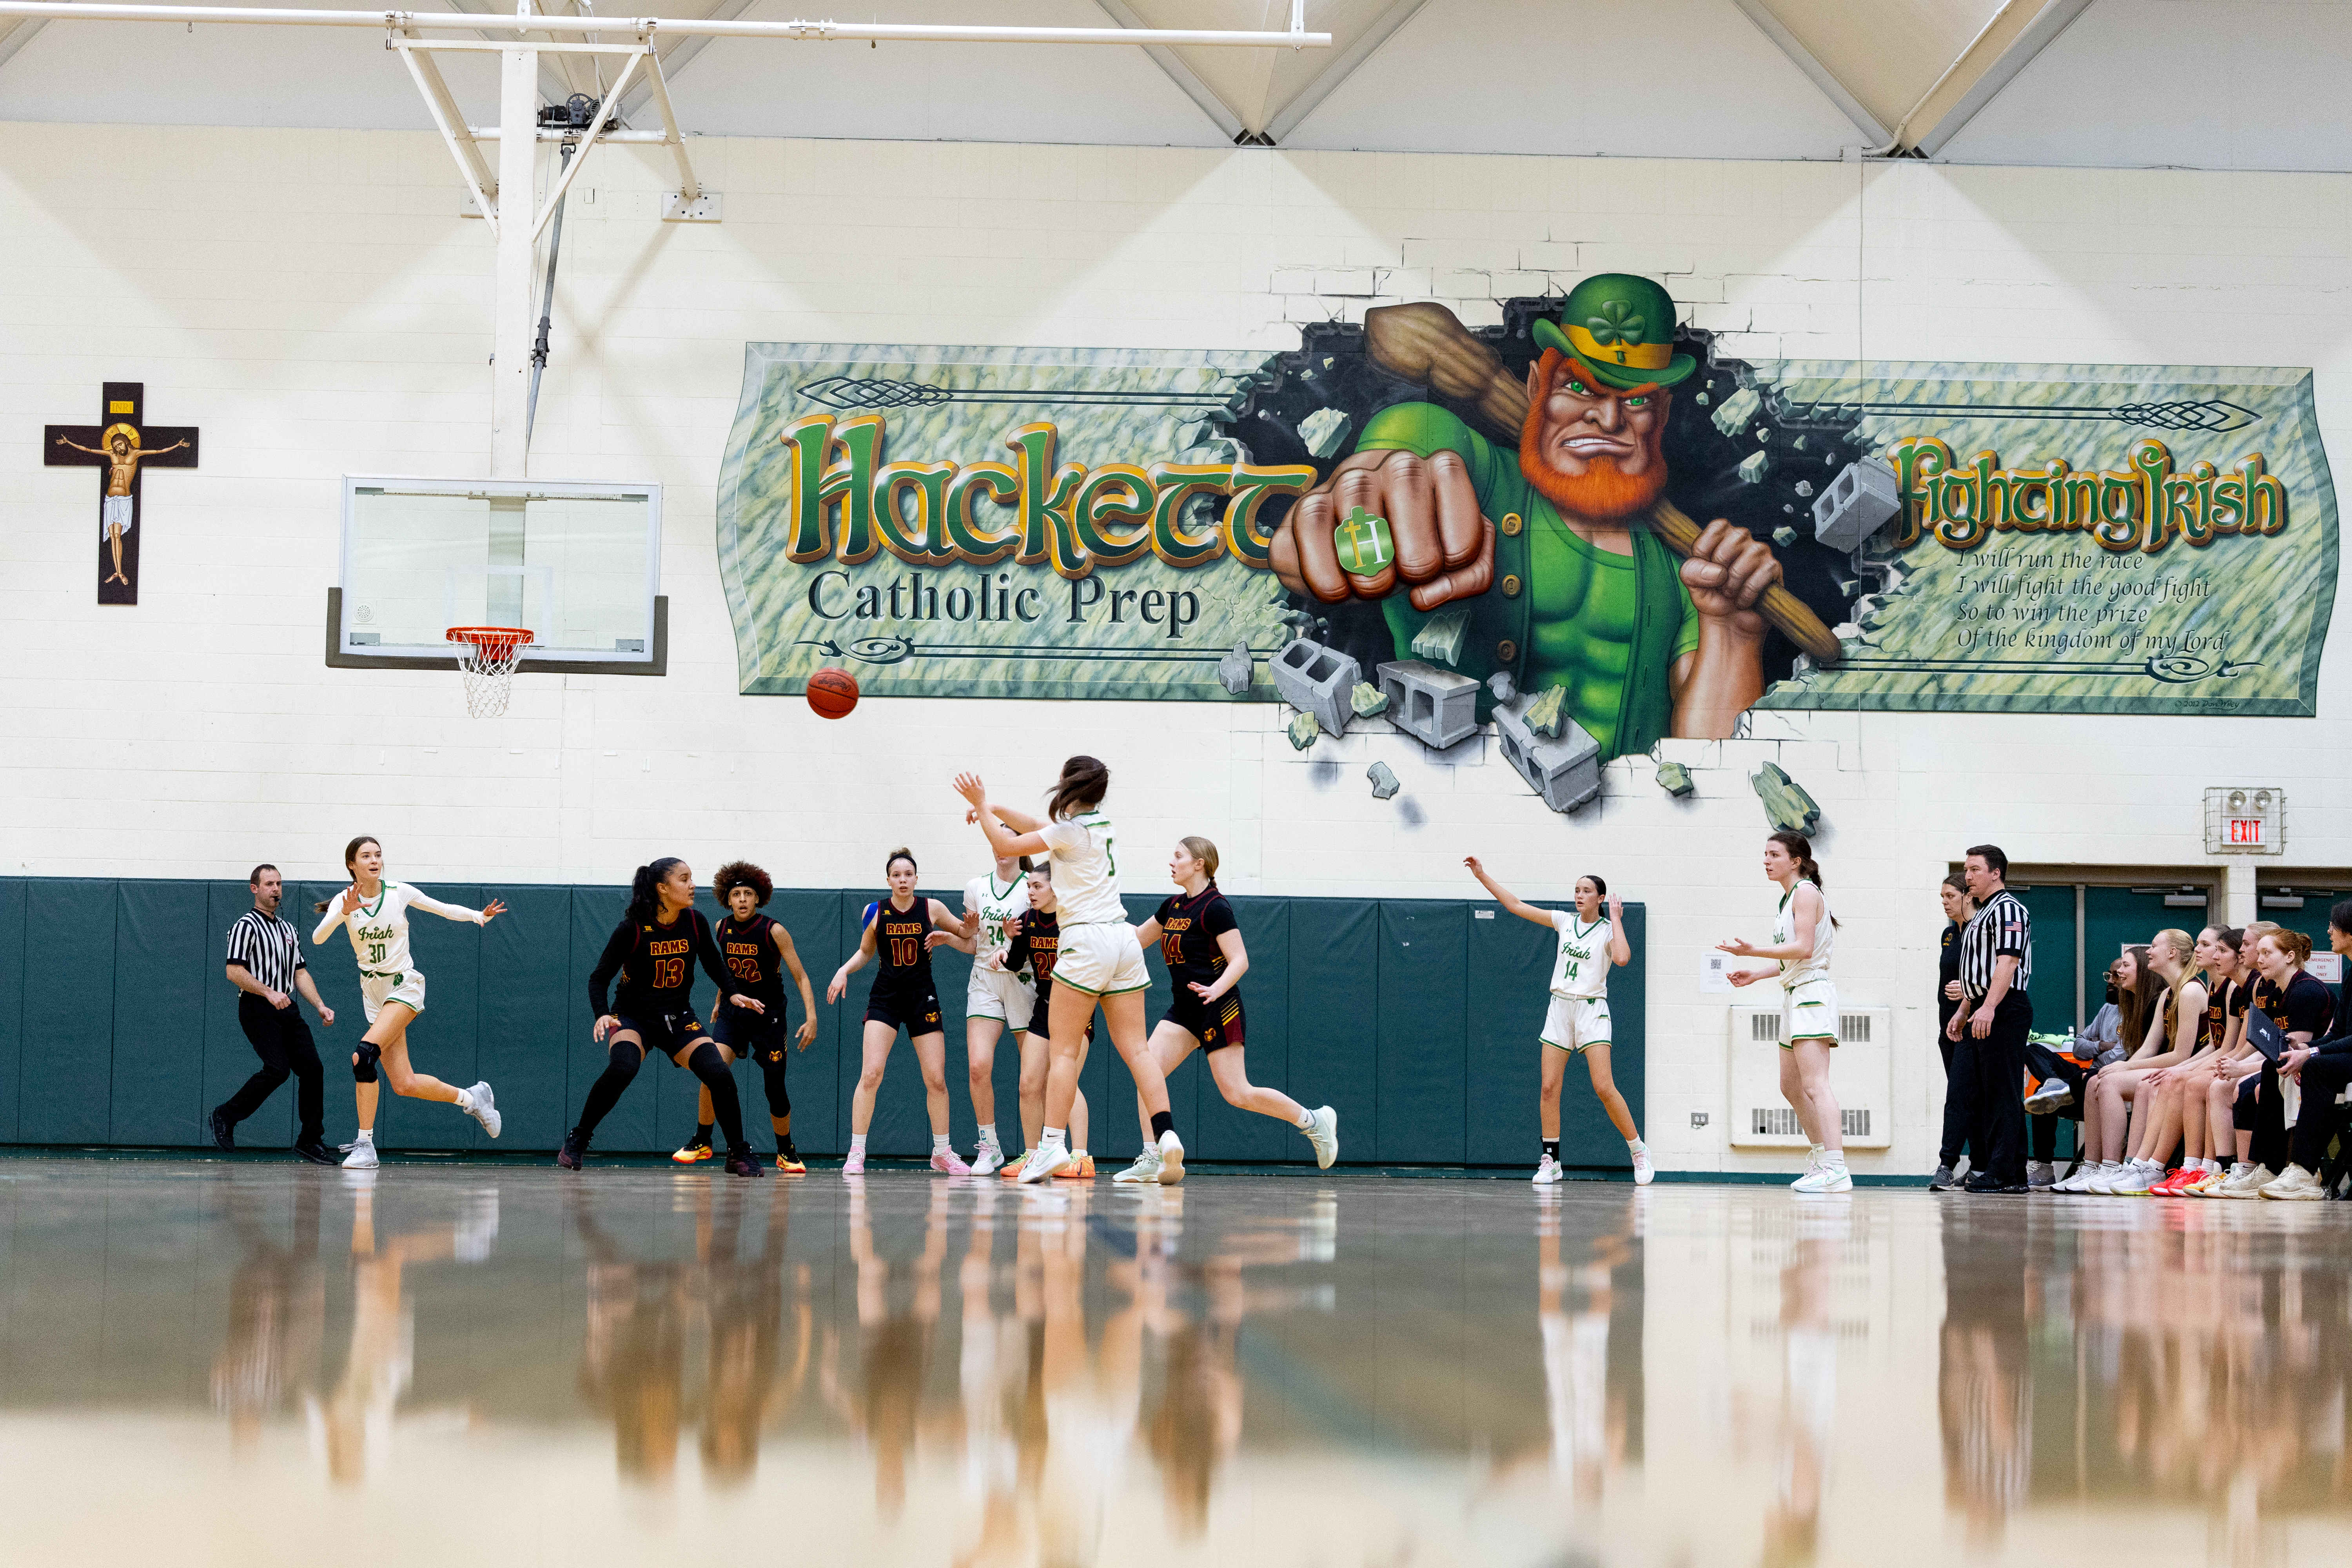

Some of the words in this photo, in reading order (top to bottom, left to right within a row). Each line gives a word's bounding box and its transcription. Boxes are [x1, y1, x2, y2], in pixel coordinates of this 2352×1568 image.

[112, 403, 132, 412] INRI
[780, 414, 1318, 580] Hackett
[1886, 436, 2143, 551] Fighting
[2129, 438, 2284, 553] Irish
[1956, 550, 1967, 566] I
[1972, 548, 2015, 568] will
[2018, 554, 2053, 568] run
[2062, 549, 2092, 568] the
[2100, 555, 2143, 569] race
[1956, 576, 1967, 593] I
[1972, 574, 2015, 594] will
[2012, 574, 2065, 601] fight
[2073, 575, 2103, 595] the
[2108, 576, 2161, 603] good
[2158, 576, 2211, 603] fight
[808, 570, 1042, 622] Catholic
[1067, 575, 1201, 640] Prep
[1957, 603, 1979, 621] So
[1986, 604, 2005, 621] to
[2013, 604, 2051, 621] win
[2058, 602, 2089, 622] the
[2091, 604, 2148, 629] prize
[1958, 627, 1983, 654] Of
[1987, 627, 2018, 648] the
[2025, 627, 2112, 655] kingdom
[2120, 629, 2142, 656] of
[2145, 636, 2177, 657] my
[2179, 629, 2230, 653] Lord
[2231, 820, 2261, 843] EXIT
[1106, 838, 1115, 876] 5
[981, 906, 1012, 922] Irish
[1164, 917, 1191, 931] RAMS
[358, 924, 394, 941] Irish
[886, 923, 922, 935] RAMS
[987, 926, 1005, 946] 34
[368, 944, 386, 964] 30
[650, 939, 689, 955] RAMS
[727, 942, 758, 955] RAMS
[891, 938, 918, 966] 10
[1160, 933, 1185, 965] 14
[1561, 942, 1591, 960] Irish
[653, 958, 685, 988] 13
[728, 957, 761, 982] 22
[1564, 961, 1578, 981] 14
